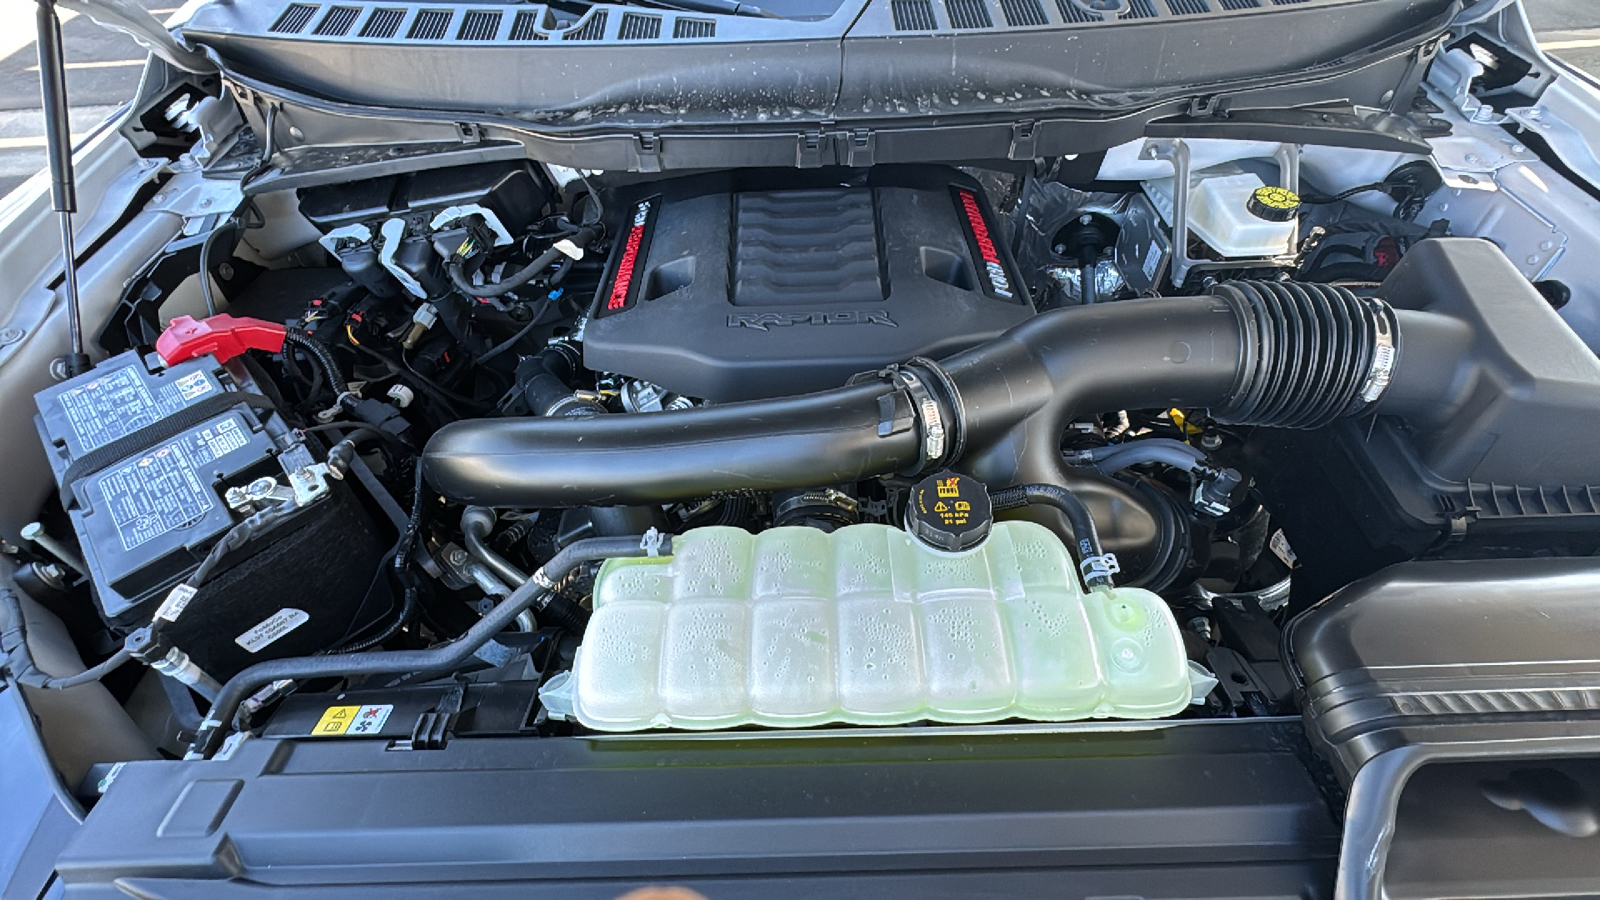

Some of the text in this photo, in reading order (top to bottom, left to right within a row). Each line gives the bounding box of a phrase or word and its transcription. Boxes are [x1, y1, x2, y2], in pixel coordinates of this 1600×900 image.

[607, 201, 651, 310] FORD PERFORMANCE
[986, 261, 1013, 298] FORD
[727, 310, 898, 332] RAPTOR
